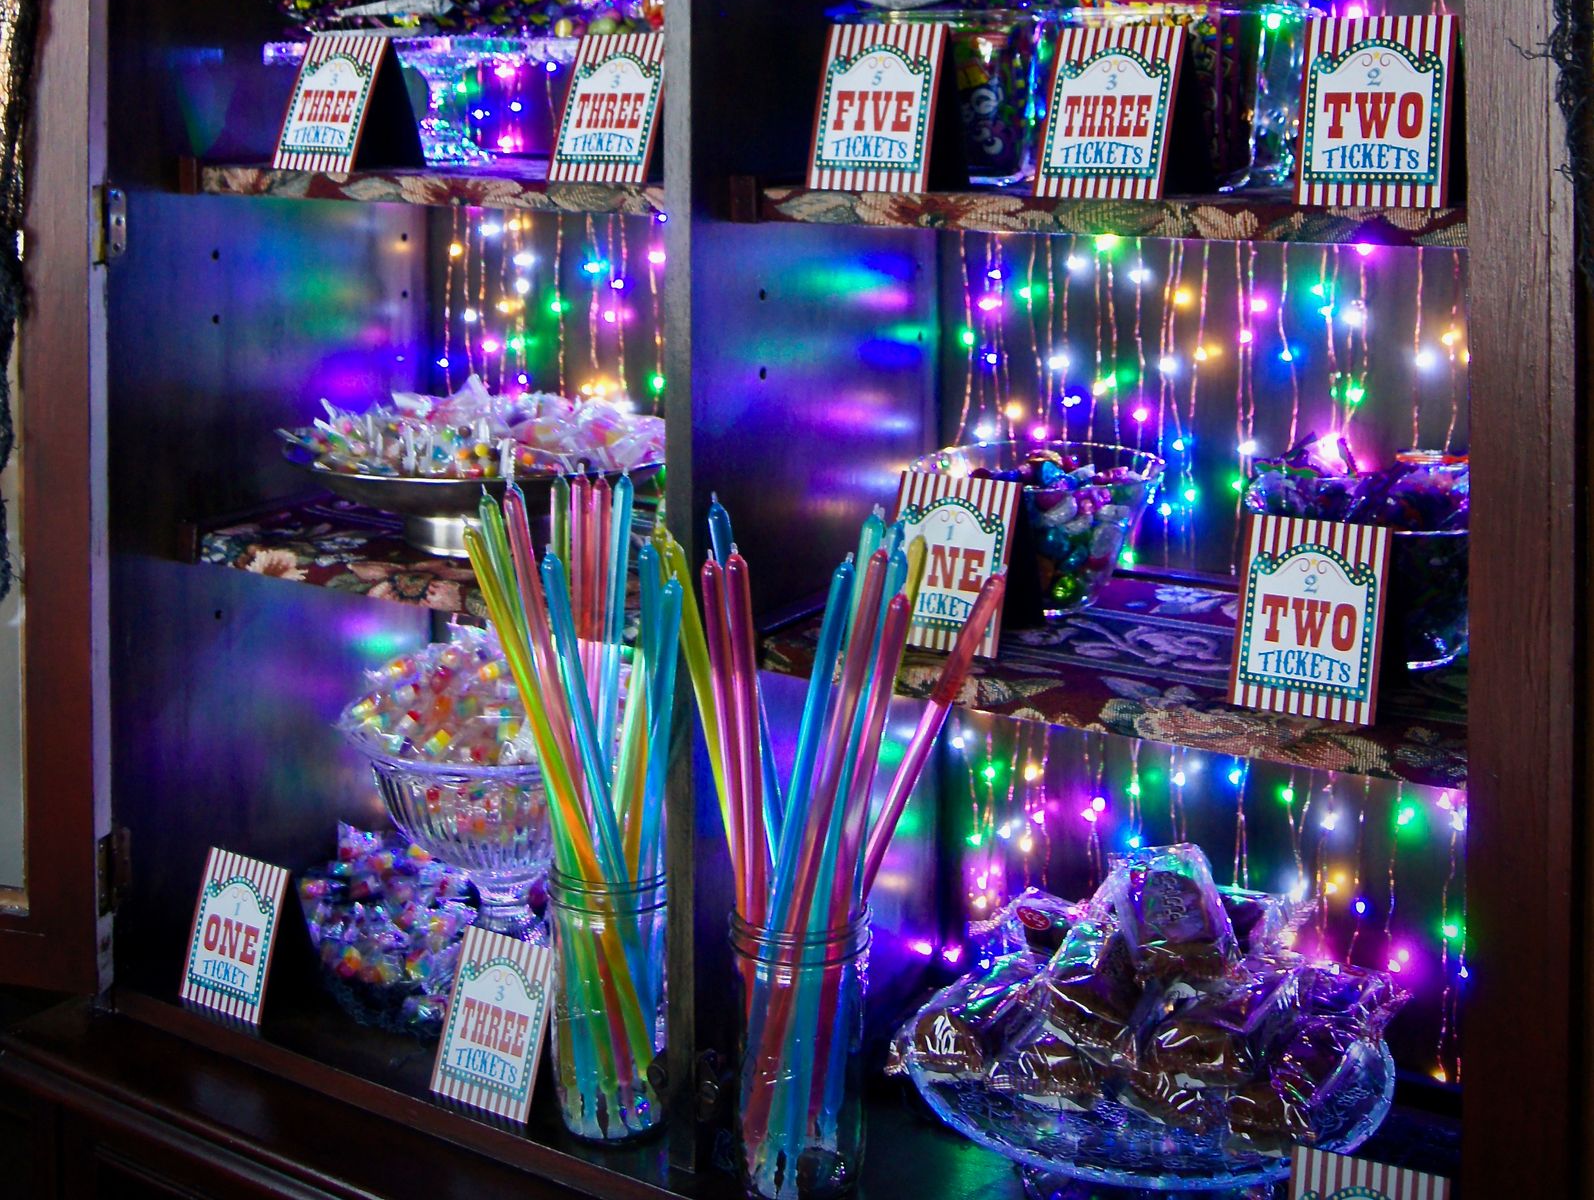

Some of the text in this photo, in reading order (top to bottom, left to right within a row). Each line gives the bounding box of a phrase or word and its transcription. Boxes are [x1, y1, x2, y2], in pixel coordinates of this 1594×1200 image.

[298, 90, 357, 123] THREE
[575, 92, 645, 129] THREE
[832, 90, 915, 132] FIVE
[1064, 94, 1153, 137] THREE
[1323, 91, 1424, 139] TWO
[294, 125, 345, 145] TICKETS
[571, 131, 634, 153] TICKETS
[831, 135, 908, 159] TICKETS
[1061, 141, 1144, 165] TICKETS
[1322, 143, 1420, 170] TICKETS
[927, 544, 986, 593] NE
[1304, 574, 1319, 593] 2
[918, 592, 974, 619] ICKET
[1261, 593, 1357, 652] TWO
[1258, 649, 1351, 683] TICKETS
[203, 913, 260, 966] ONE
[203, 959, 249, 988] TICKET
[460, 996, 530, 1058] THREE
[456, 1047, 518, 1083] TICKETS
